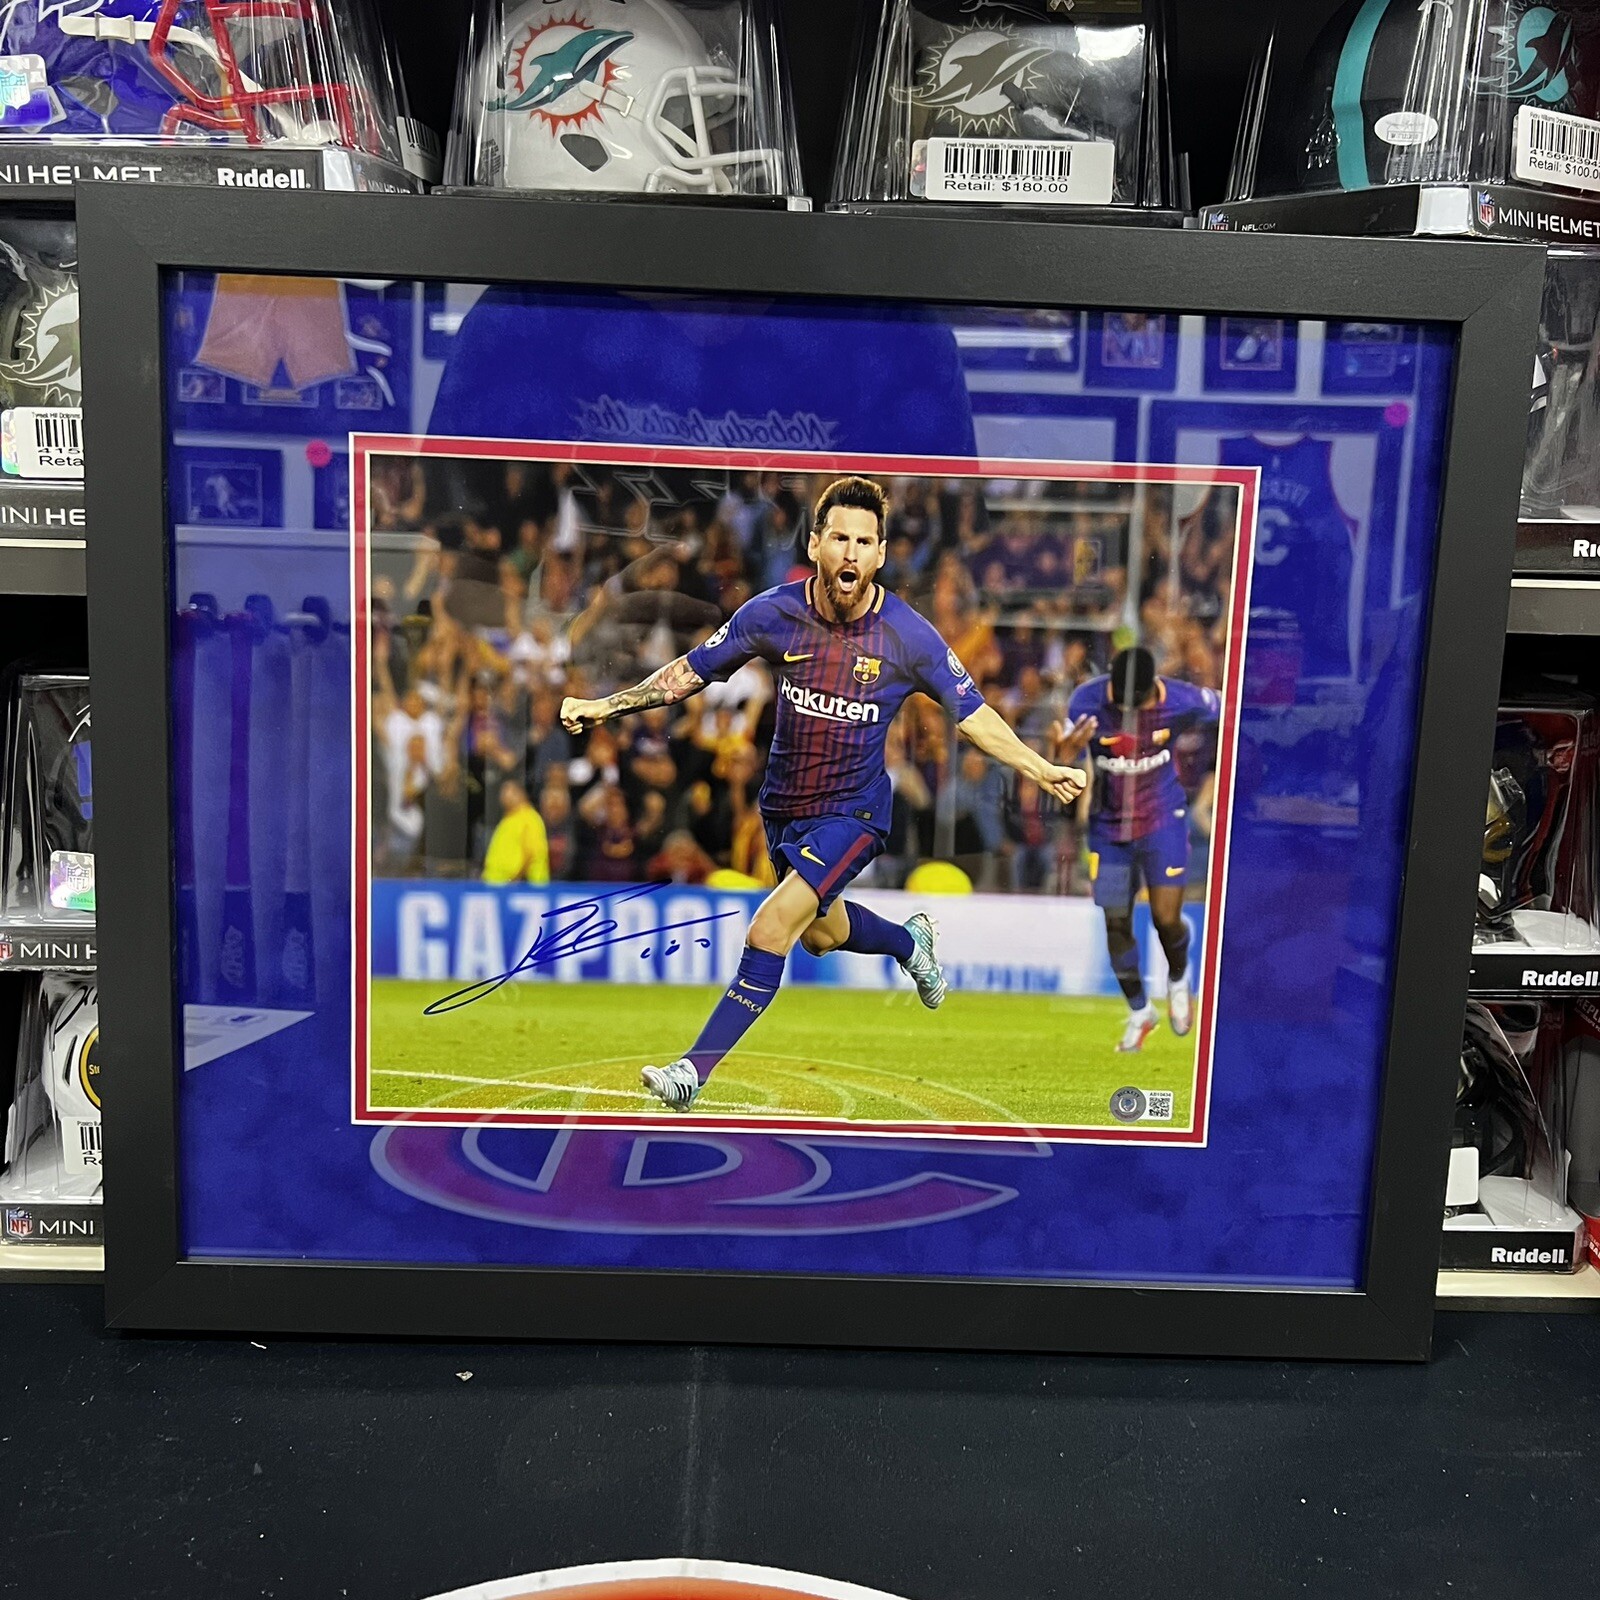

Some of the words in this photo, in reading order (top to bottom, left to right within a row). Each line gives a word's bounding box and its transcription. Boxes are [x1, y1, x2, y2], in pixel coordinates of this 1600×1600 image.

[1530, 148, 1600, 168] 415695394
[1529, 157, 1562, 172] Retail:
[1565, 163, 1600, 180] $100.0
[944, 180, 996, 192] Retail:
[1001, 181, 1069, 194] $180.00
[1499, 207, 1534, 228] MINI
[781, 676, 880, 723] Rakuten
[20, 943, 77, 959] MINI
[727, 989, 763, 1014] BARÇA
[39, 1219, 94, 1236] MINI
